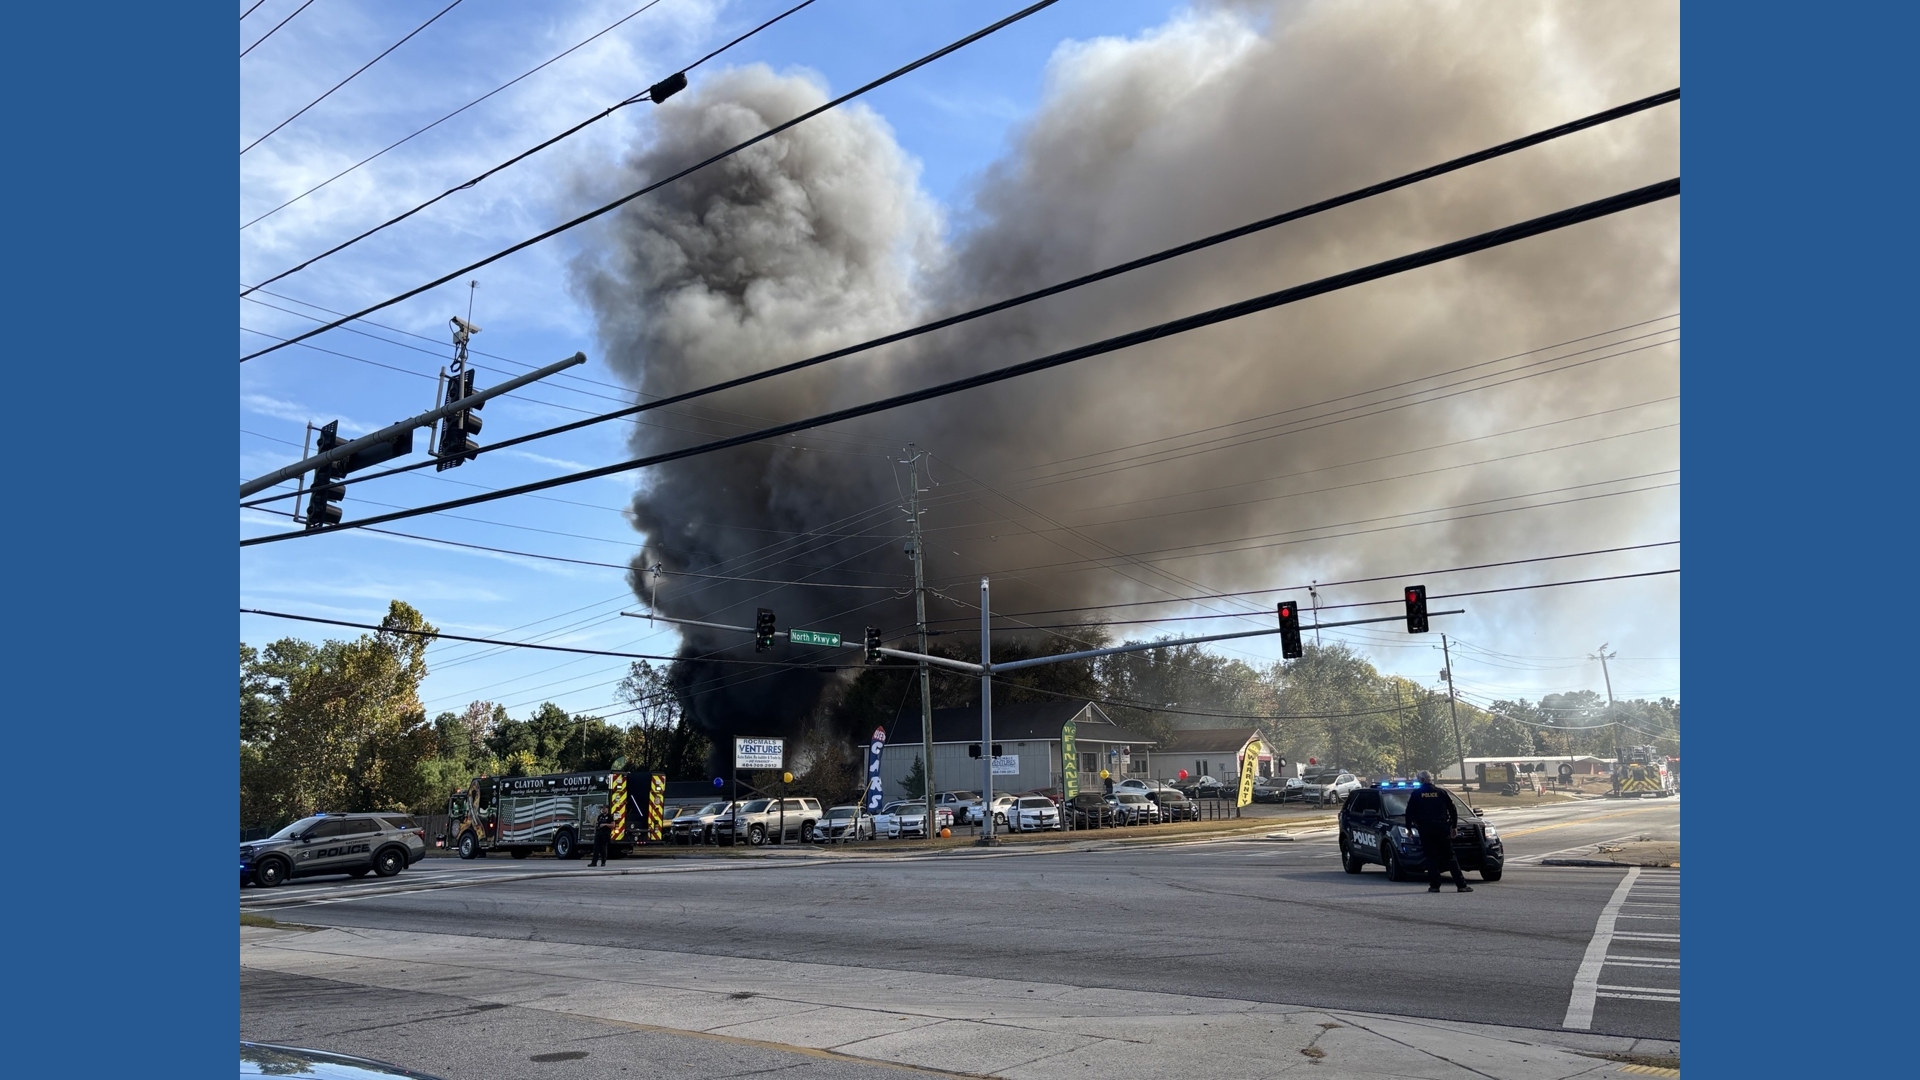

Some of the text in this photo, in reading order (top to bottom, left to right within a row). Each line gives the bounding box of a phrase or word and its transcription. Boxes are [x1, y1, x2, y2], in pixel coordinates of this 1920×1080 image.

[791, 631, 831, 645] North Pkwy
[739, 744, 782, 753] VENTURES
[1064, 734, 1078, 798] FINANCE
[514, 776, 592, 789] CLAYTON COUNTY
[869, 741, 883, 809] CARS
[1242, 754, 1255, 805] WARRANTY
[1352, 830, 1376, 848] POLICE
[317, 843, 371, 859] POLICE
